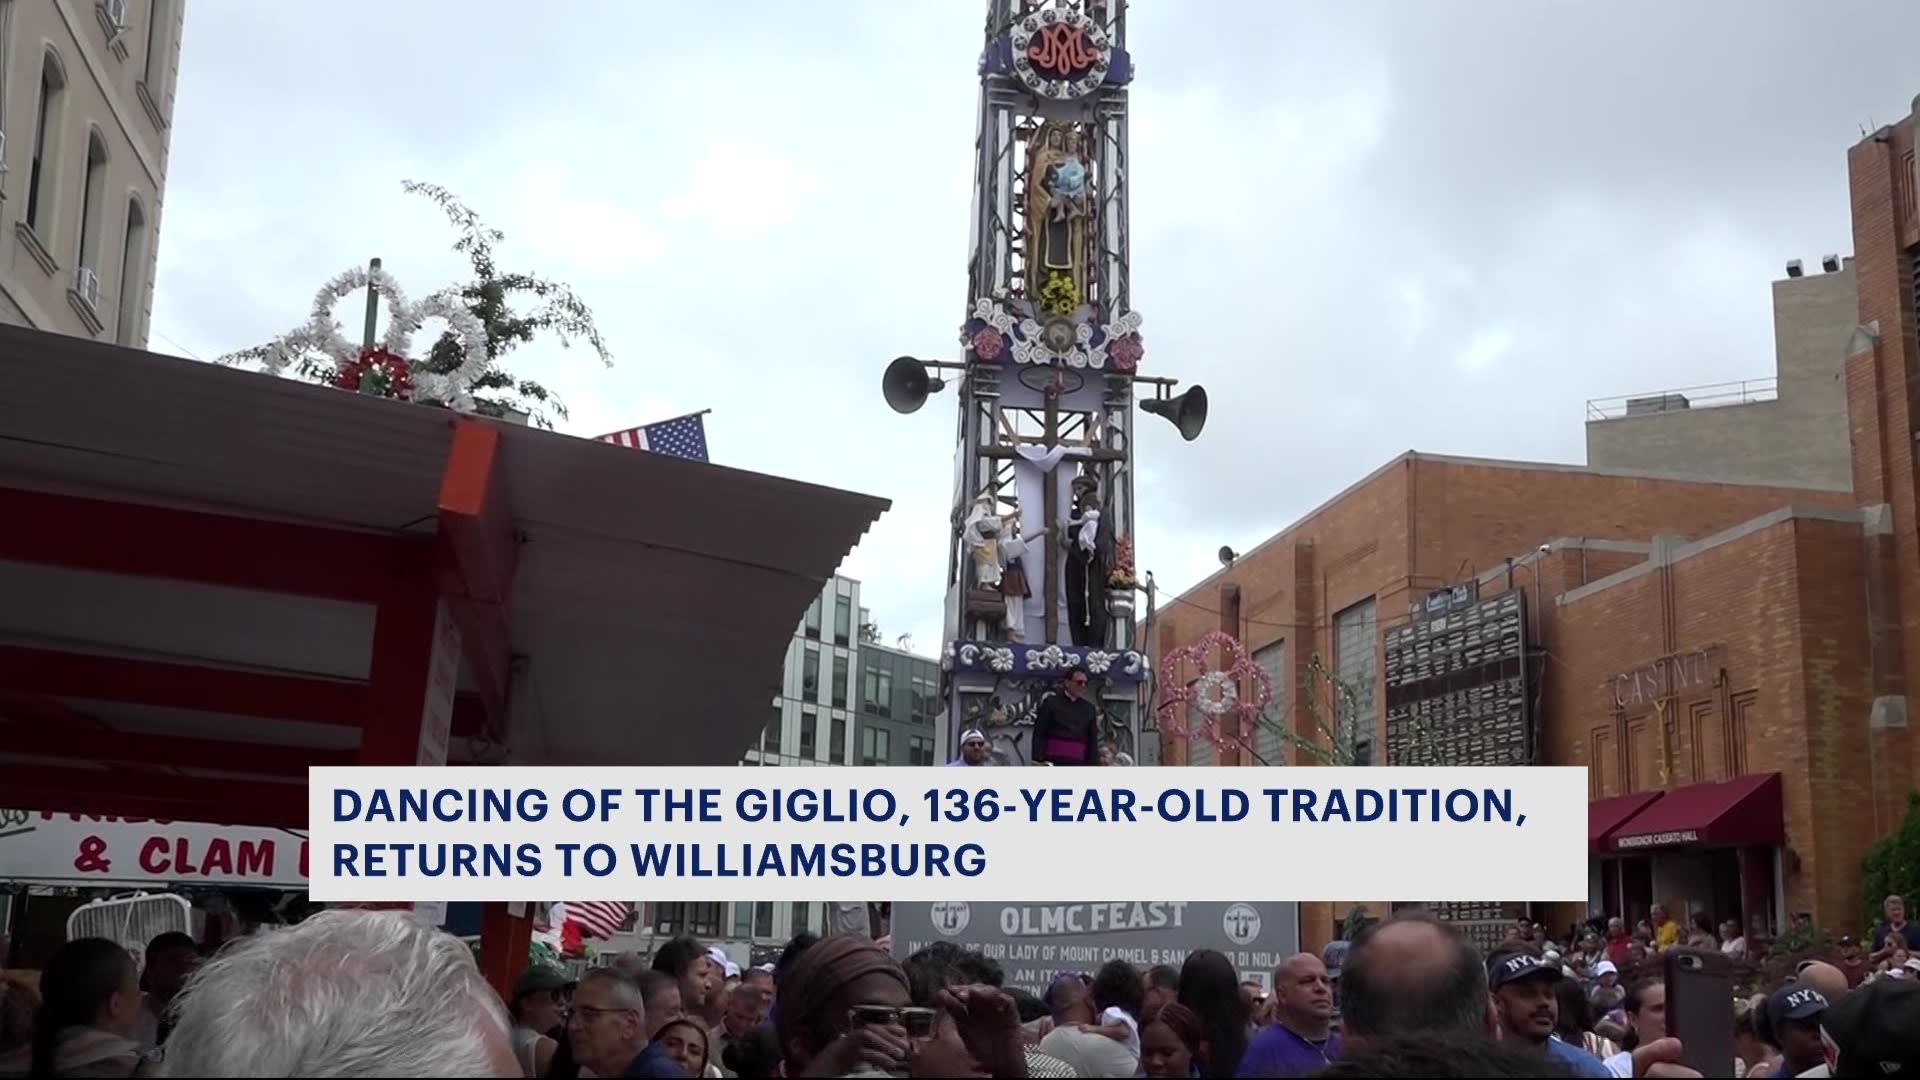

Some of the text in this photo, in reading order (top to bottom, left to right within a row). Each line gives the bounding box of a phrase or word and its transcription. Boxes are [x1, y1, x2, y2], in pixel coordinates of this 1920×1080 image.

[74, 836, 110, 872] &
[139, 836, 275, 876] CLAM
[1001, 901, 1188, 936] OLMC FEAST
[983, 943, 1005, 960] OUR
[1009, 944, 1039, 960] LADY
[1042, 945, 1056, 960] OF
[1059, 946, 1099, 962] MOUNT
[1103, 947, 1148, 964] CARMEL
[1151, 948, 1159, 963] &
[1162, 949, 1185, 964] SAN
[1239, 952, 1250, 967] DI
[1252, 952, 1281, 967] NOLA
[1015, 968, 1035, 982] AN
